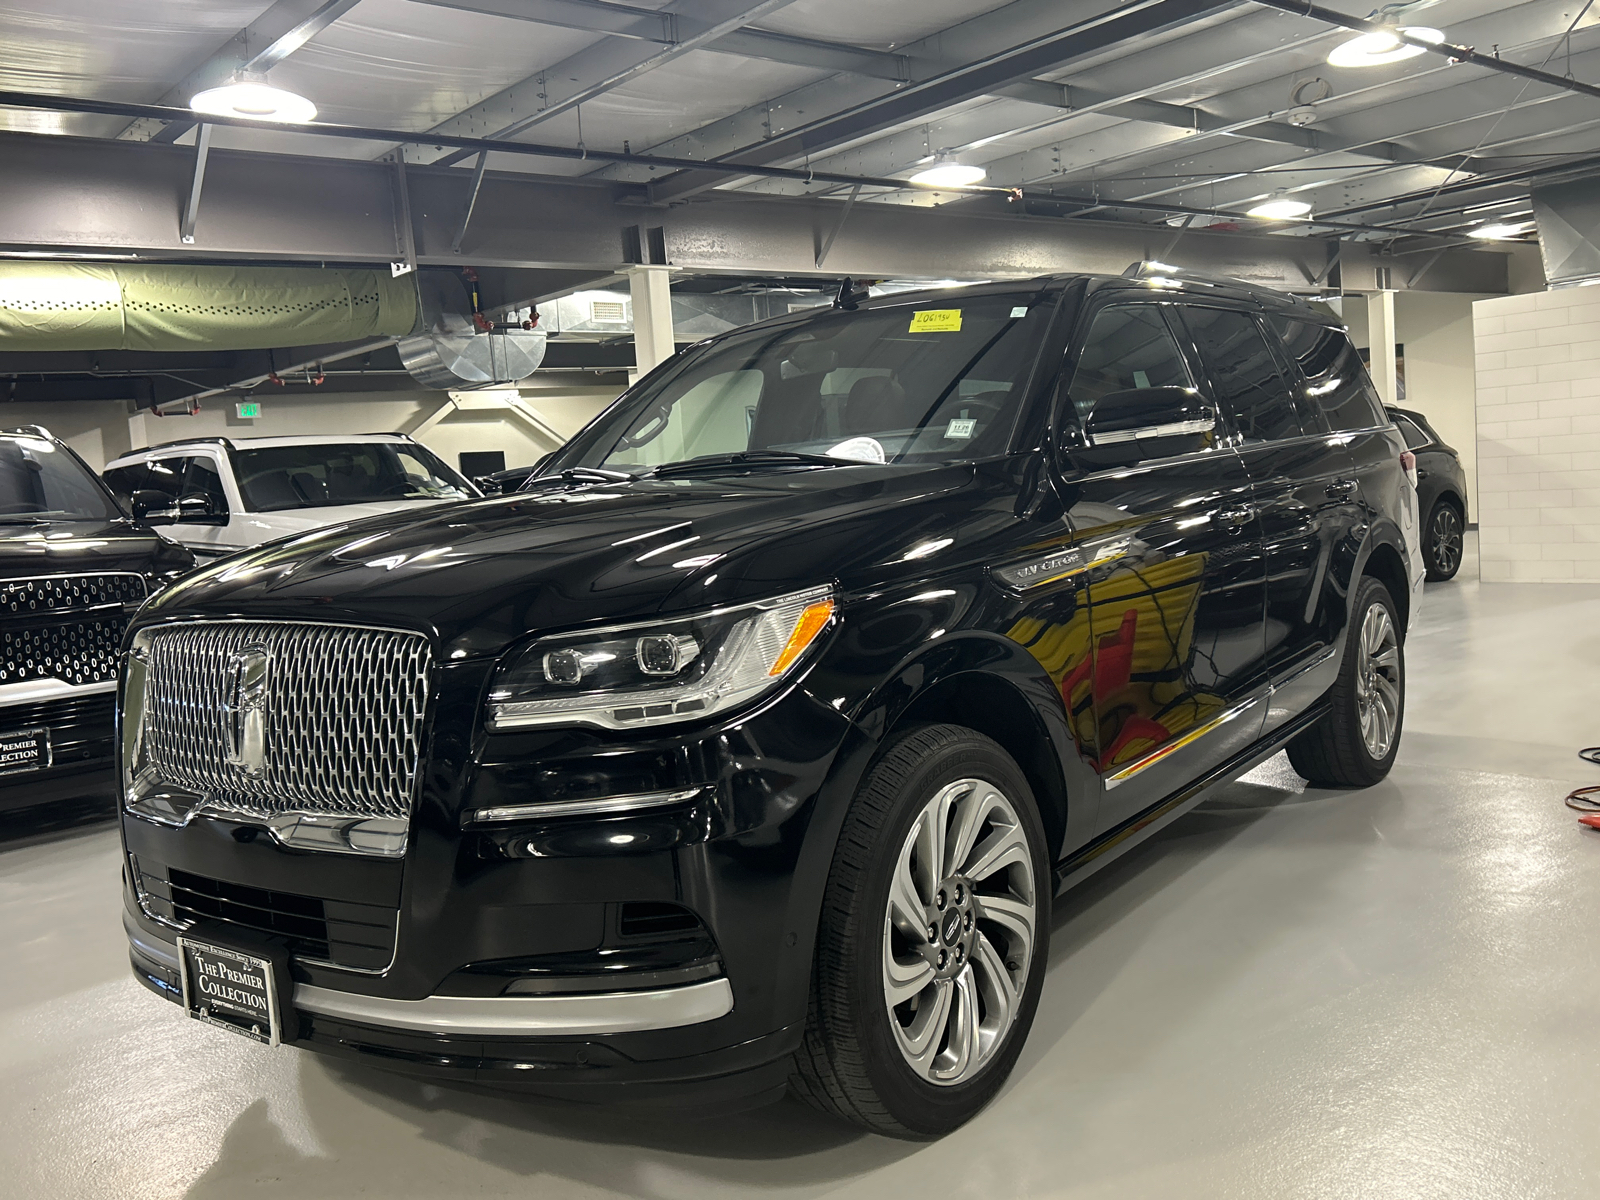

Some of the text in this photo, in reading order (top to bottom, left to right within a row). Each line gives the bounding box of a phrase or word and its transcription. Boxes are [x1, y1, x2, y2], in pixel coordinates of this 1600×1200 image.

[241, 404, 257, 417] EXIT
[919, 753, 967, 792] GRABBER
[210, 946, 236, 959] EXCELLENCE
[236, 953, 249, 963] SINCE
[195, 956, 264, 990] THE PREMIER
[199, 975, 267, 1011] COLLECTION
